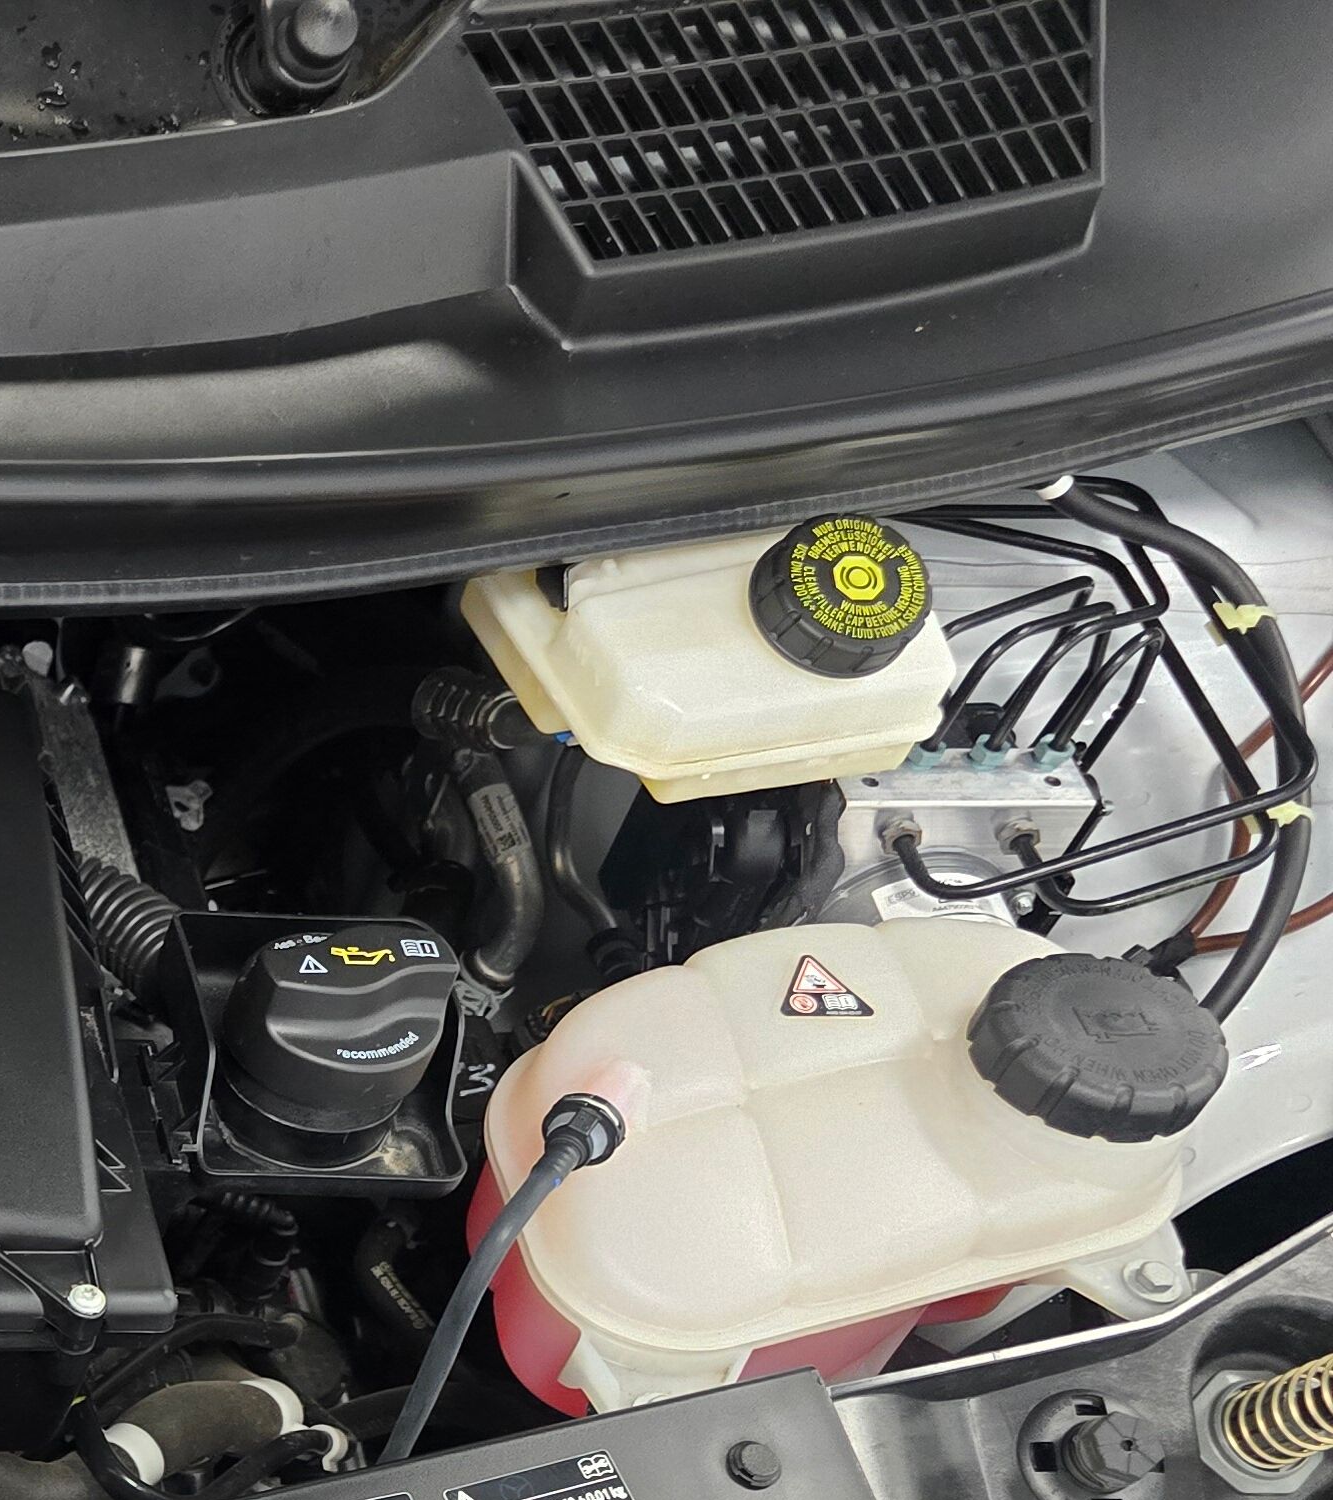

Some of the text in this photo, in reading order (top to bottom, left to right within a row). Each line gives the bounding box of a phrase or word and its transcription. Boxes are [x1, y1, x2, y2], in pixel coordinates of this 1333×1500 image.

[812, 519, 884, 538] NUR ORIGINAL
[821, 541, 887, 563] VERWENDEN
[790, 561, 804, 583] ONLY
[813, 610, 847, 634] BRAKE
[845, 626, 875, 640] FLUID
[875, 623, 902, 640] FROM
[803, 566, 819, 595] CLEAN
[815, 594, 847, 621] FILLER
[845, 616, 867, 627] CAP
[865, 608, 902, 628] BEFORE
[840, 600, 888, 617] WARNING
[336, 1031, 420, 1060] recommended
